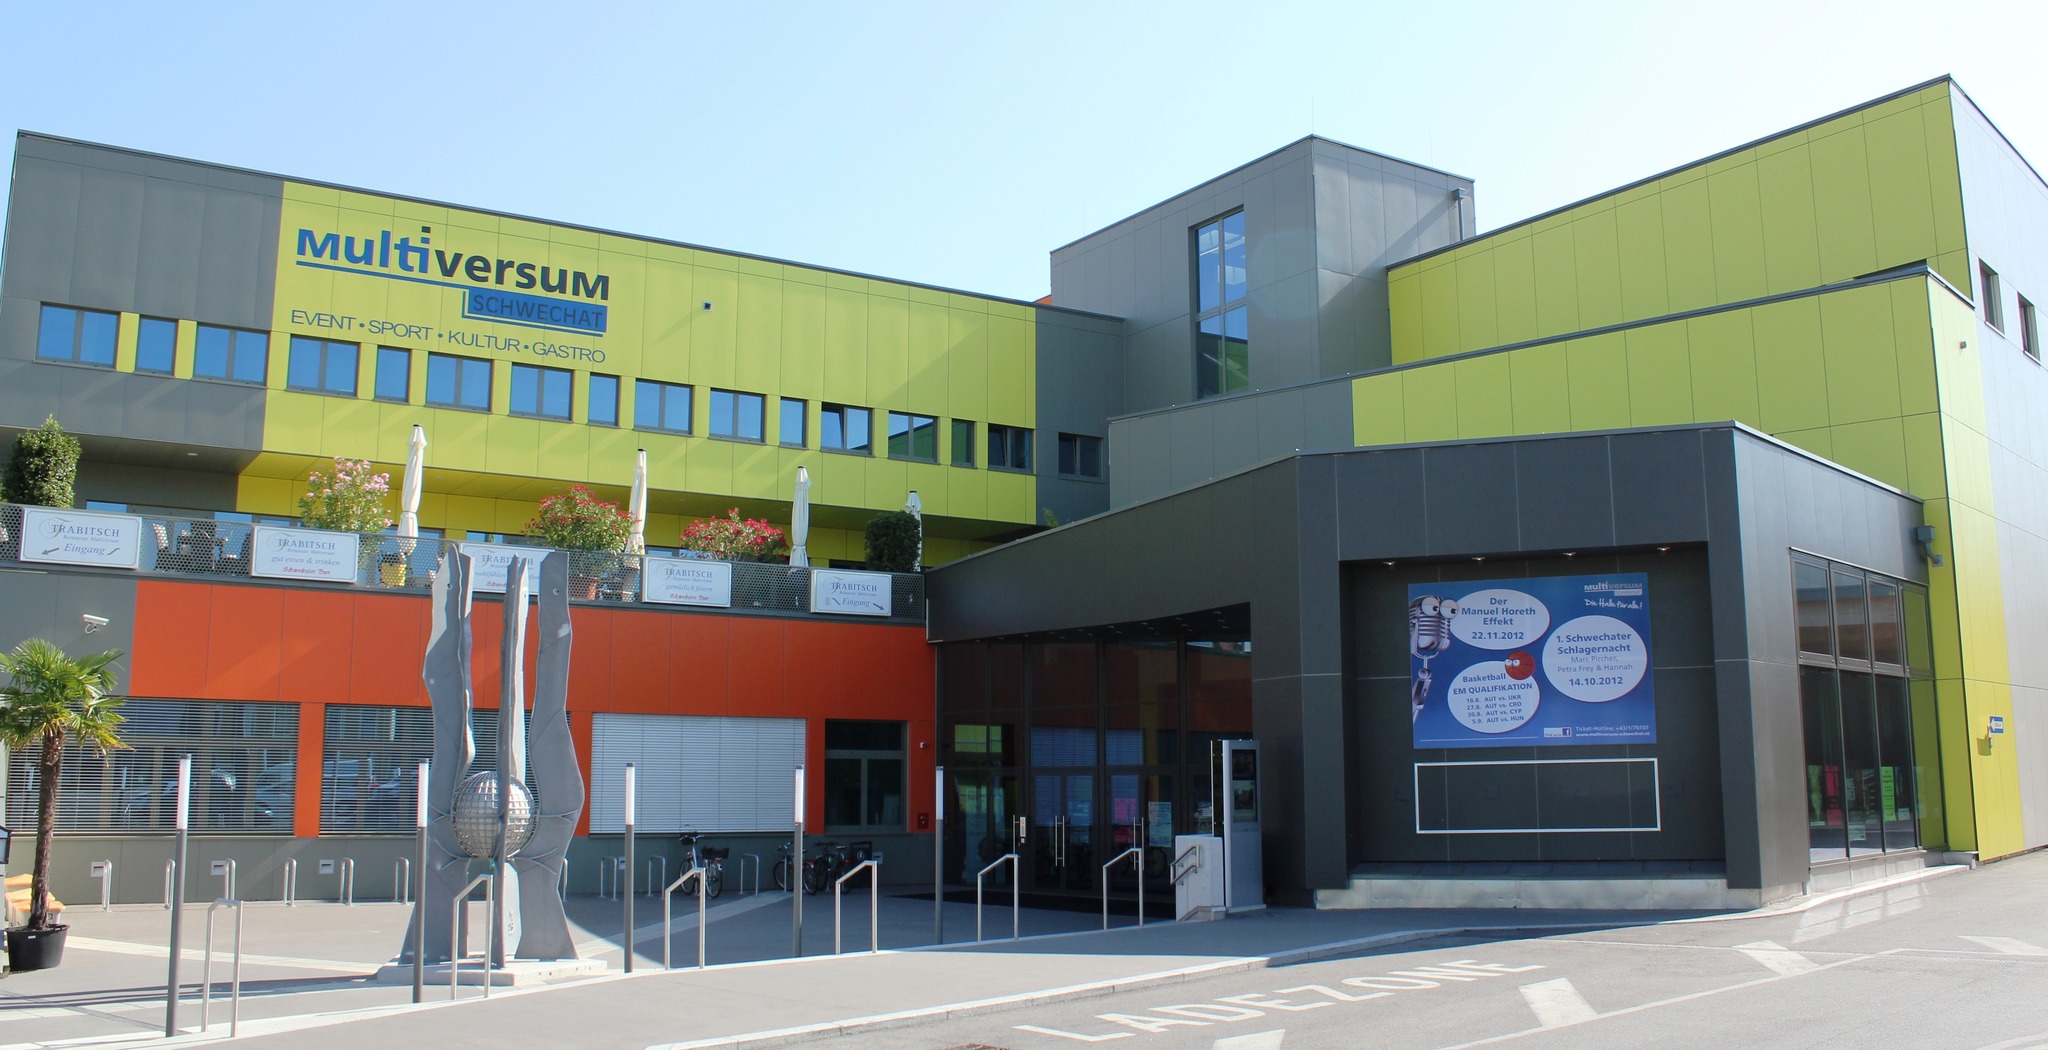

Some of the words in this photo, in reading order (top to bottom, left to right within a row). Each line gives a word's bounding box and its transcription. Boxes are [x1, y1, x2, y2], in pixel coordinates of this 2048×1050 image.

[473, 293, 604, 329] SCHWECHAT
[291, 309, 356, 331] EVENT
[368, 320, 433, 341] SPORT
[448, 330, 520, 352] KULTUR
[532, 341, 606, 364] GASTRO
[45, 519, 120, 538] TRABITSCH
[271, 534, 336, 551] TRABITSCH
[64, 543, 106, 556] Eingang
[315, 558, 341, 566] trinken
[660, 565, 713, 579] TRABITSCH
[827, 578, 878, 593] TRABITSCH
[842, 597, 871, 607] Eingang
[1490, 597, 1508, 606] Der
[1584, 598, 1598, 606] Die
[1599, 597, 1616, 608] Halle
[1461, 607, 1499, 616] Manuel
[1501, 607, 1536, 616] Horeth
[1483, 617, 1514, 626] Effekt
[1471, 631, 1524, 640] 22.11.2012
[1556, 635, 1564, 643] 1.
[1565, 632, 1632, 643] Schwechater
[1557, 643, 1632, 655] Schlagernacht
[1578, 665, 1595, 673] Frey
[1603, 663, 1633, 671] Hannah
[1462, 672, 1507, 683] Basketball
[1568, 676, 1624, 686] 14.10.2012
[1453, 687, 1467, 695] EM
[1468, 682, 1534, 695] QUALIFIKATION
[1012, 959, 1548, 1042] LADEZONE
